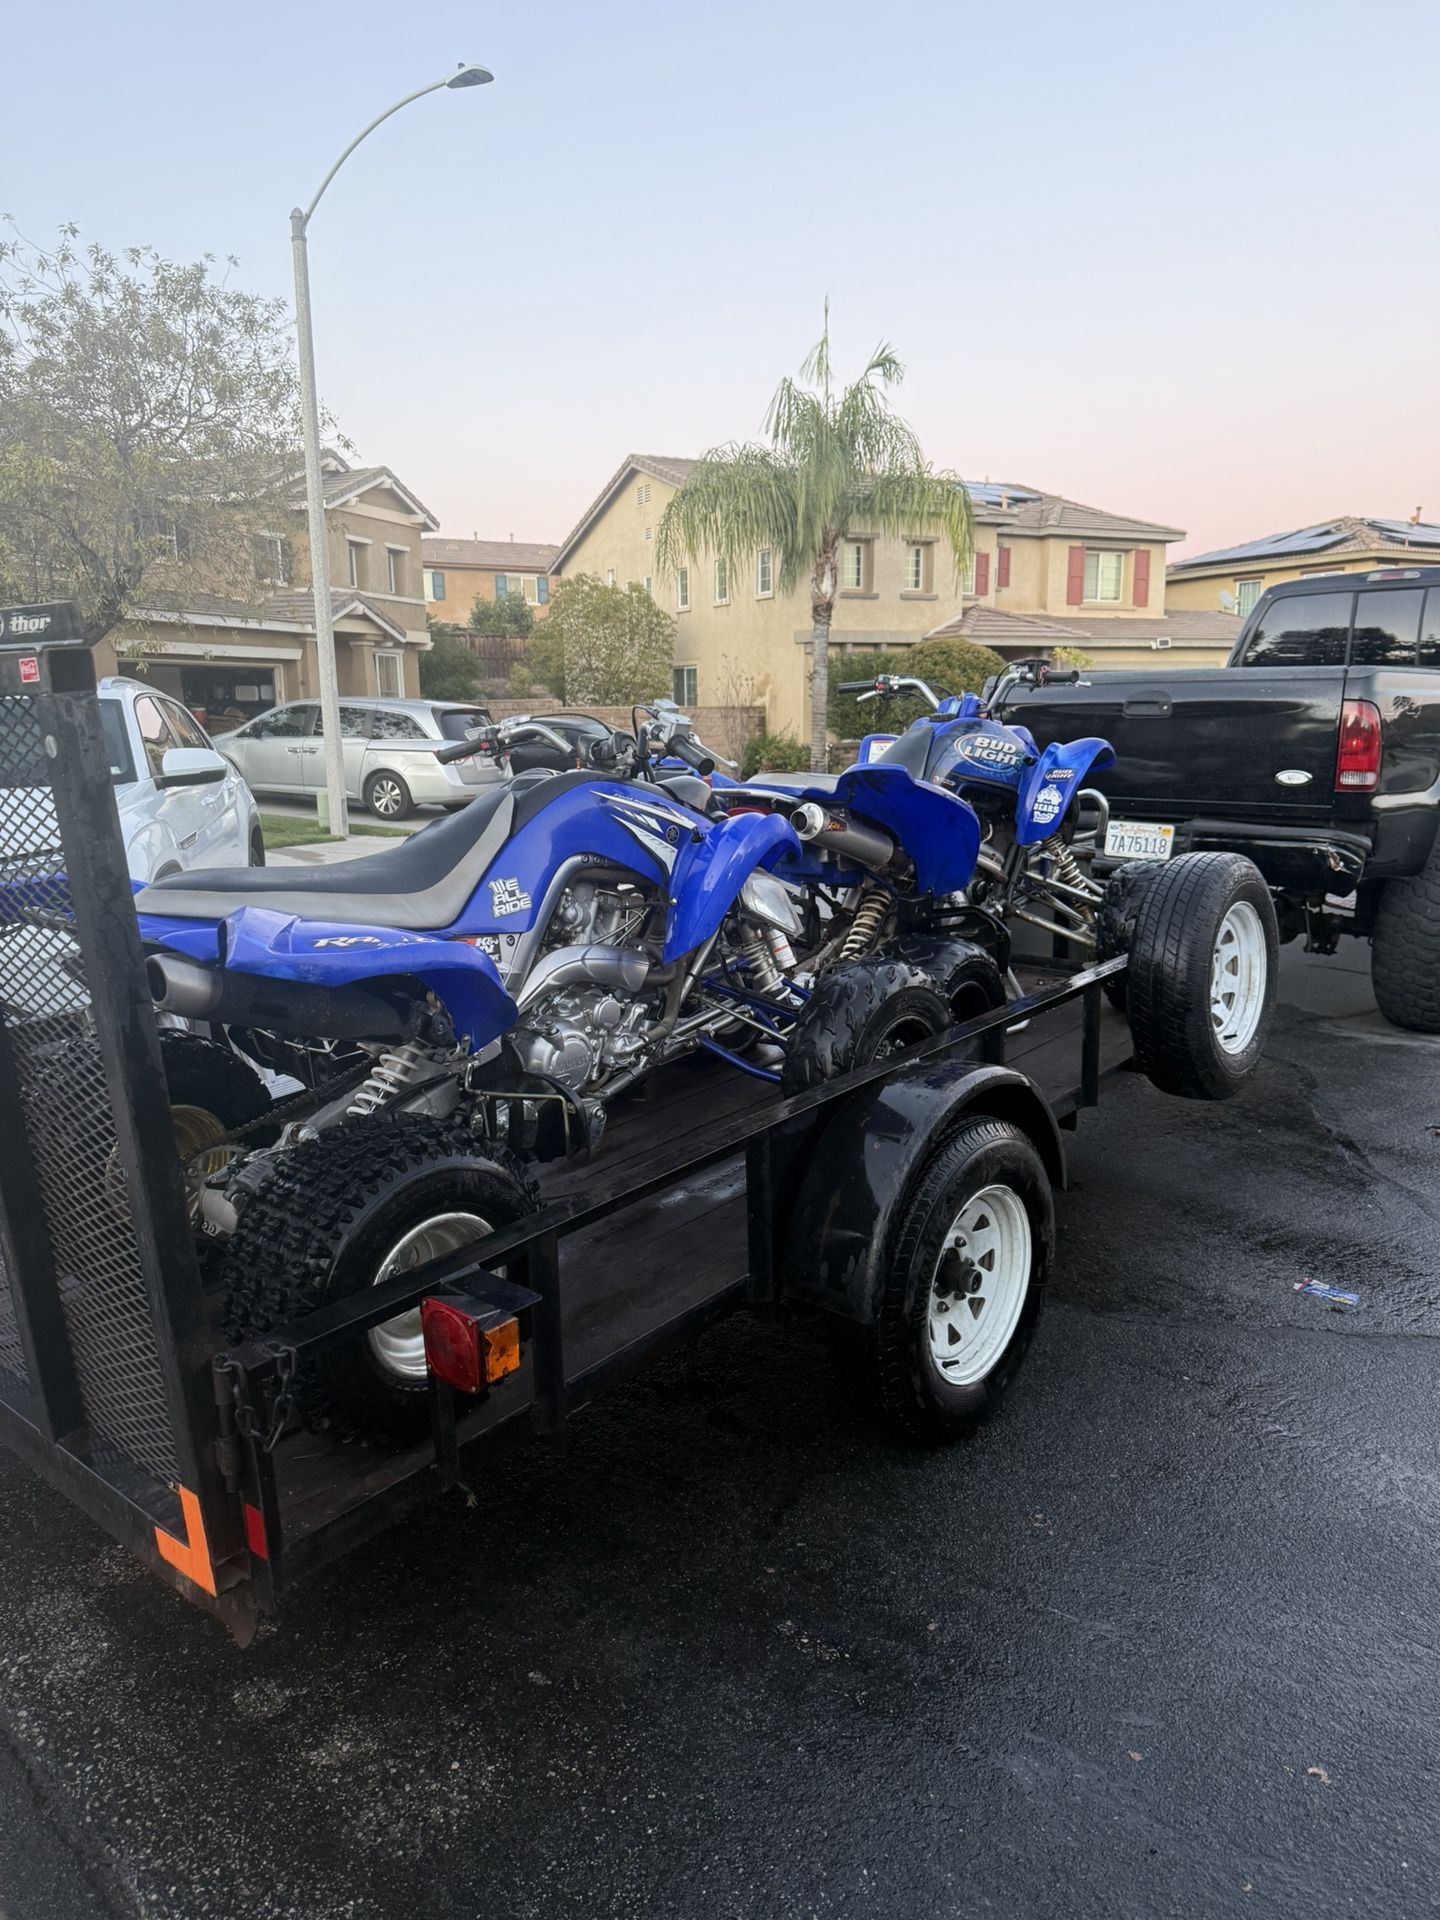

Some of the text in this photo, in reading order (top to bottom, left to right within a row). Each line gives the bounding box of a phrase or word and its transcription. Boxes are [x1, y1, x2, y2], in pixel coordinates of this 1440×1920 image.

[9, 615, 51, 632] thor
[974, 737, 1017, 754] BUD
[963, 746, 1020, 765] LIGHT
[1033, 803, 1060, 814] BEARS
[1110, 834, 1168, 855] 7A75118
[494, 888, 529, 906] ALL
[493, 897, 532, 918] RIDE
